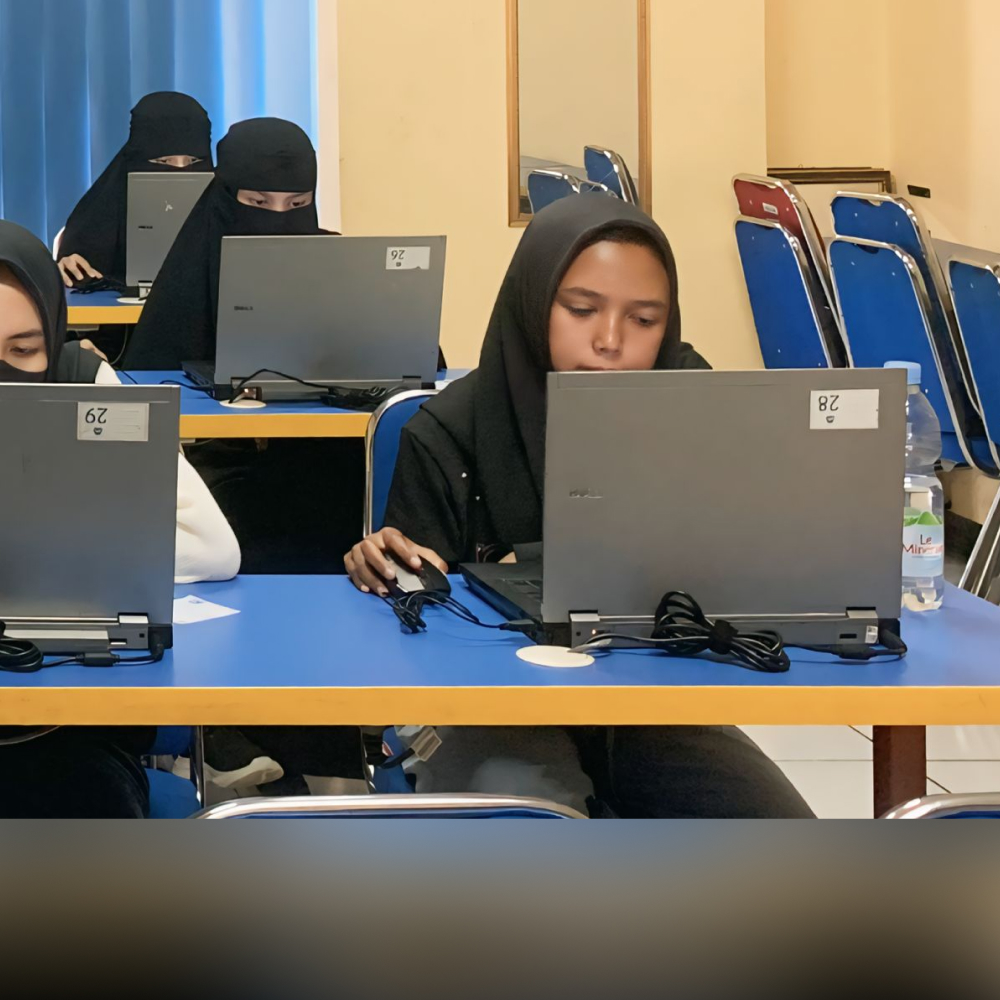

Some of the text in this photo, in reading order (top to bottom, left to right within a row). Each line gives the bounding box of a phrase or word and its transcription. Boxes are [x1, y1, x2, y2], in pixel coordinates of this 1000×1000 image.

[391, 249, 406, 261] 26
[818, 394, 840, 412] 28
[85, 407, 108, 424] 29
